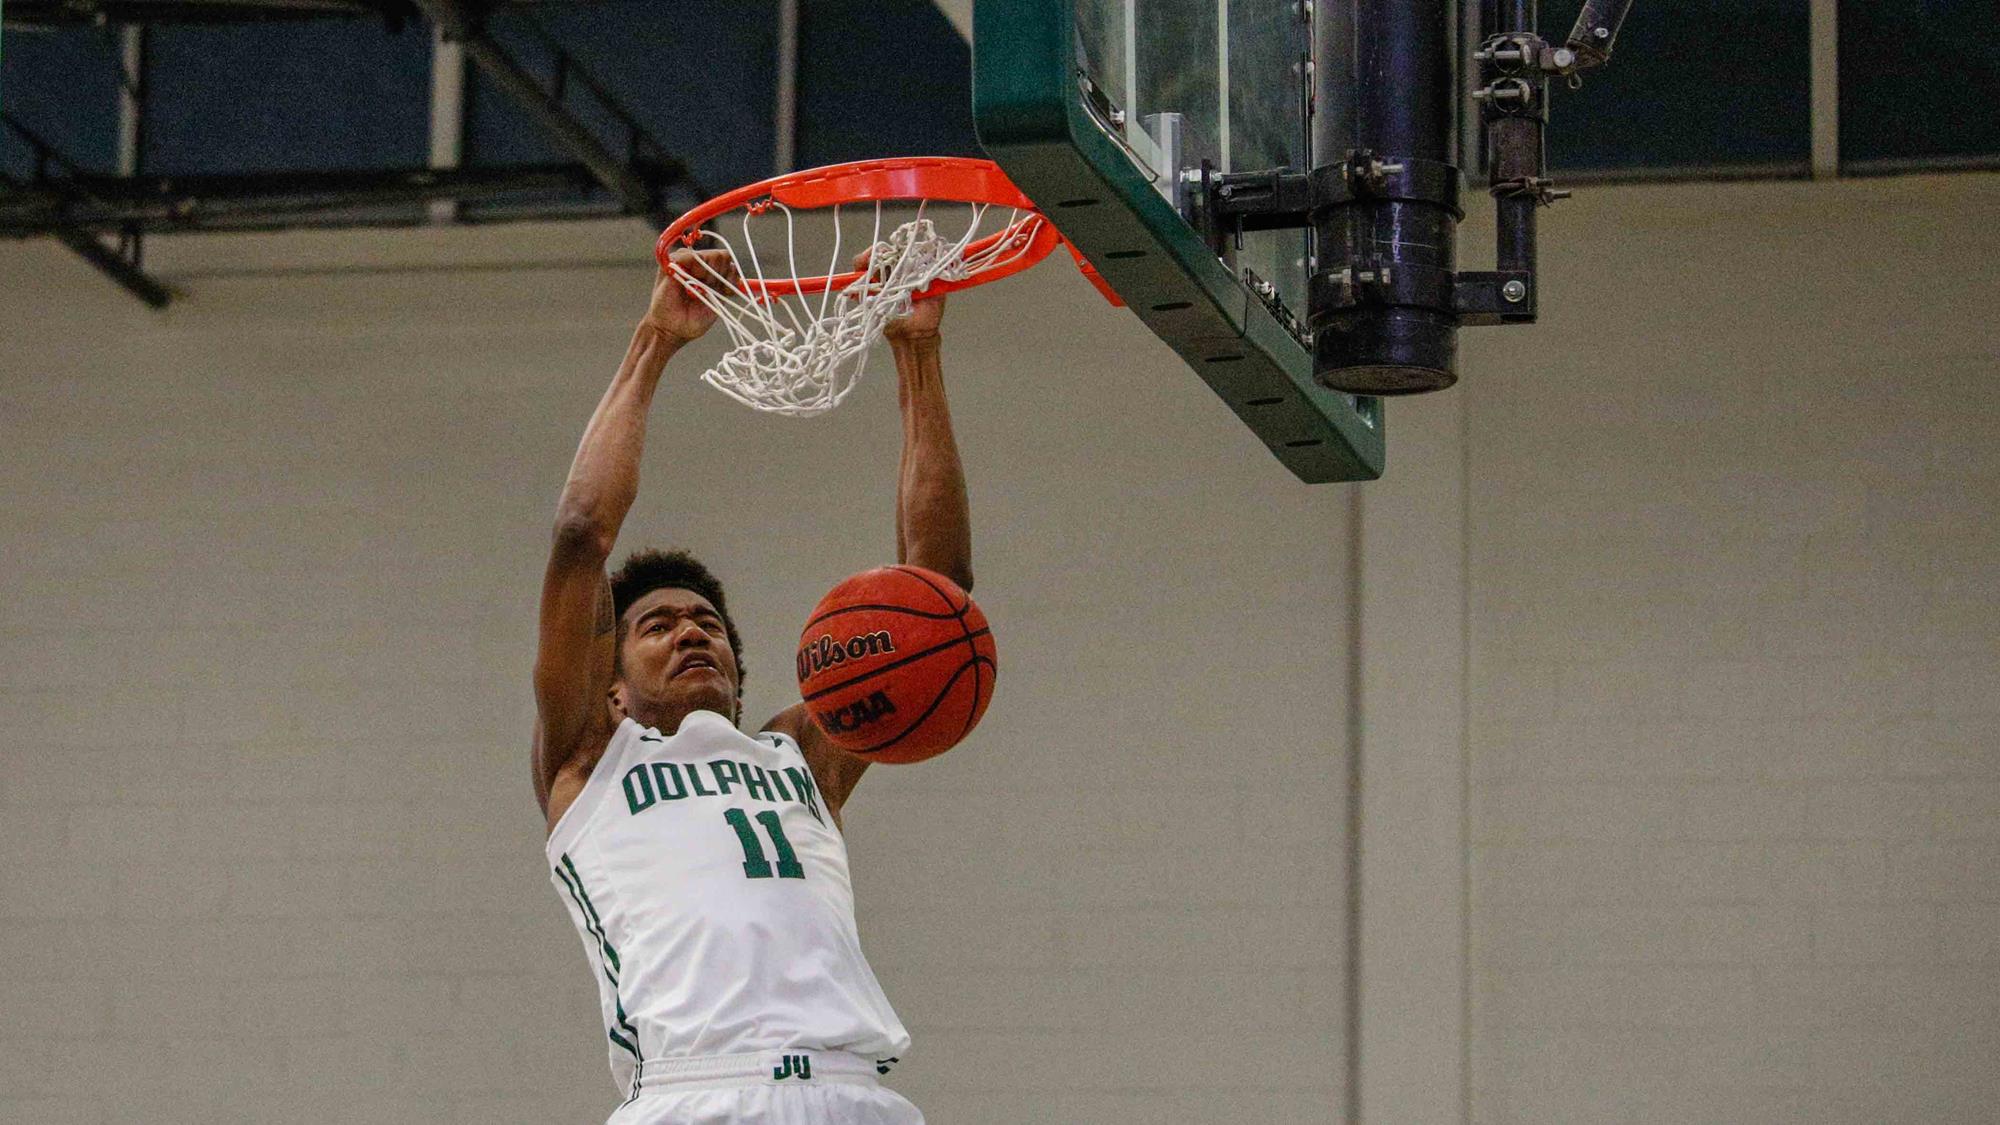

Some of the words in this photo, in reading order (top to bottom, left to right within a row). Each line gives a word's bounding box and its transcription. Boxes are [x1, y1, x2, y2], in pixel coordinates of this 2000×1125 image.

[816, 690, 896, 734] NCAA
[723, 807, 806, 879] 11
[773, 1054, 812, 1080] JU
